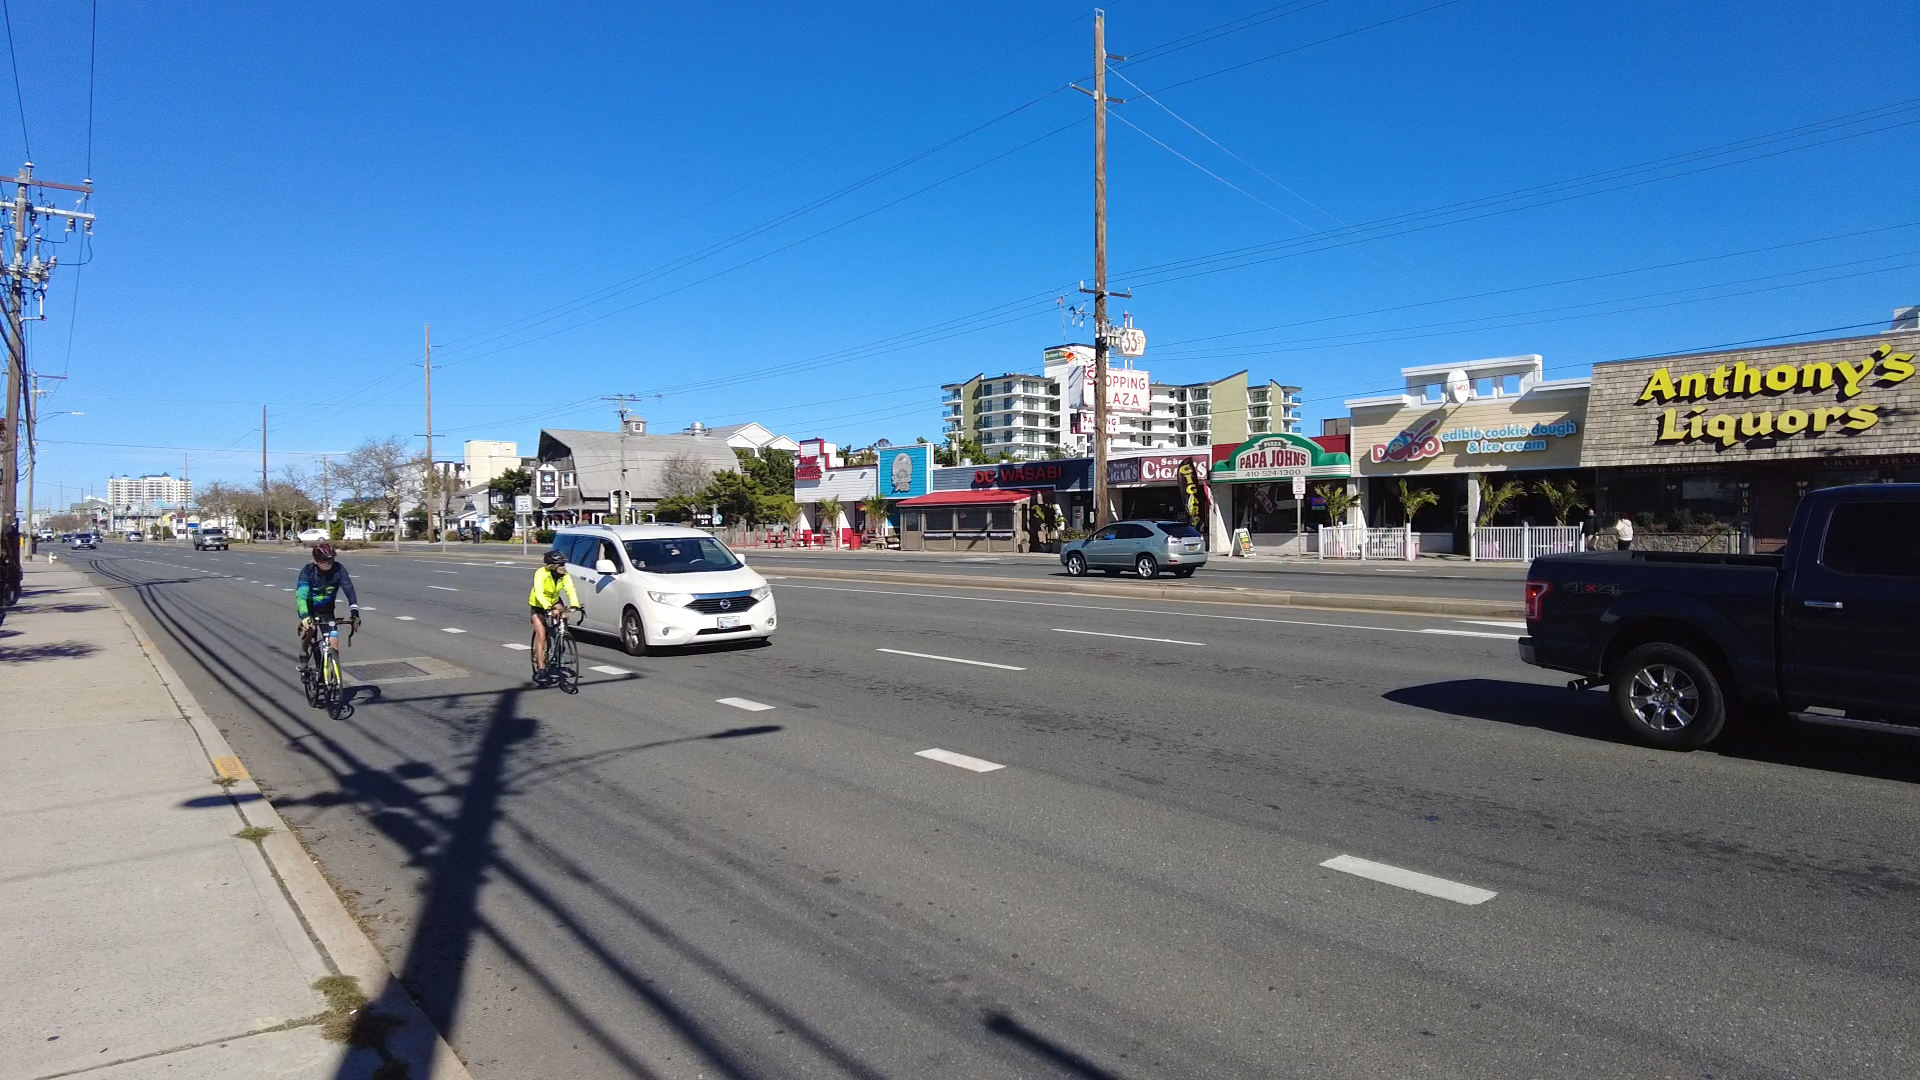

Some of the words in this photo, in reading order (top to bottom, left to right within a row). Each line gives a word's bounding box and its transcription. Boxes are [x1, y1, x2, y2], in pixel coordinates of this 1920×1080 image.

[1124, 331, 1138, 352] 33
[1087, 369, 1146, 390] SOPPING
[1639, 343, 1916, 399] Anthony's
[1442, 427, 1482, 442] edible
[1484, 424, 1527, 439] cookie
[1529, 420, 1576, 439] dough
[1658, 404, 1880, 447] Liquors
[1467, 441, 1480, 454] &
[1481, 441, 1502, 453] ice
[1503, 440, 1546, 452] cream
[1240, 451, 1267, 469] PAPA
[1671, 464, 1722, 473] DRINKS
[1823, 458, 1873, 467] CRAFT
[974, 470, 995, 484] OC
[1000, 465, 1062, 481] WASABI
[1245, 470, 1260, 478] 410
[1262, 469, 1301, 477] 524-1300
[519, 503, 530, 511] 35
[1741, 490, 1750, 515] BAR
